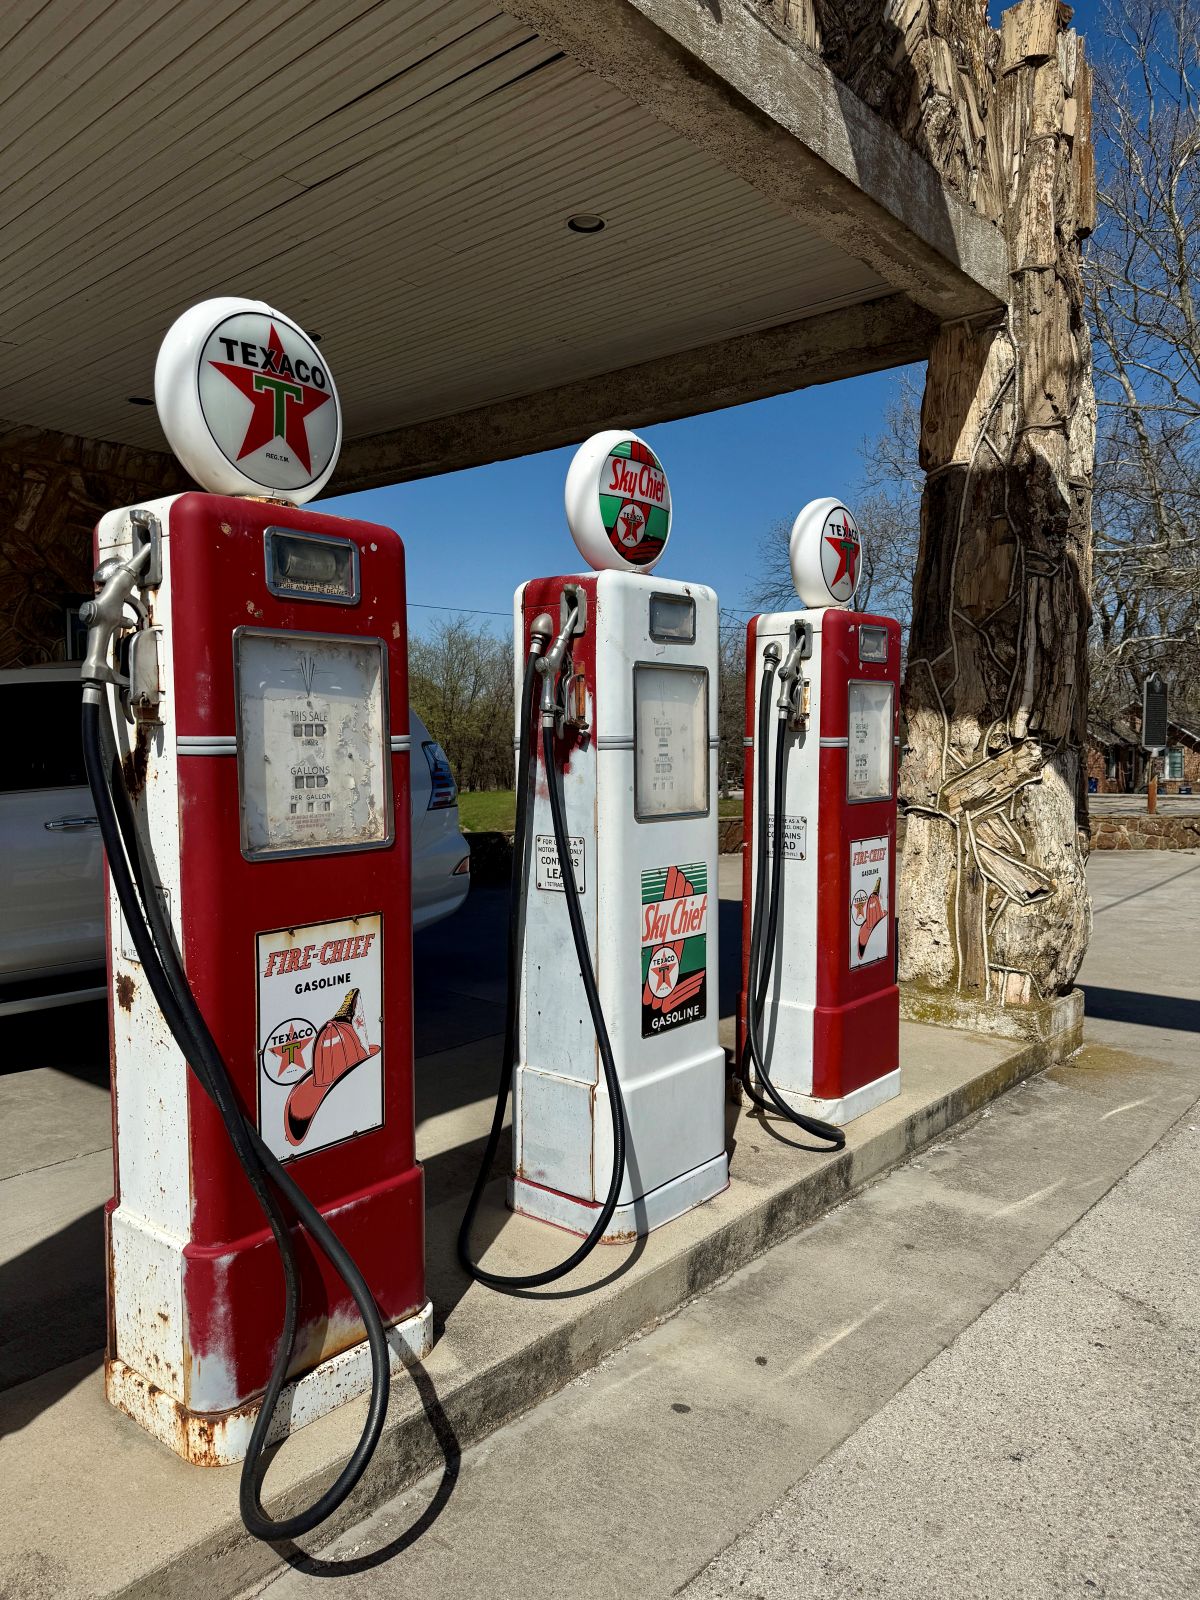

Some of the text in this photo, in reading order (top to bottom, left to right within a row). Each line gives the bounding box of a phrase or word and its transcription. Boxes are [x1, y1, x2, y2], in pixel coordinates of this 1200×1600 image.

[218, 336, 326, 389] TEXACO
[253, 372, 304, 440] T
[609, 458, 666, 503] Sky Chief
[623, 512, 643, 521] TEXACO
[829, 523, 859, 542] TEXACO
[840, 541, 855, 573] T
[290, 710, 328, 722] THIS SALE
[290, 765, 331, 775] GALLONS
[306, 793, 331, 801] GALLON
[641, 894, 708, 943] Sky Chief
[261, 933, 376, 978] FIRE-CHIEF
[653, 954, 675, 966] TEXACO
[294, 972, 352, 995] GASOLINE
[651, 1004, 700, 1030] GASOLINE
[271, 1027, 313, 1046] TEXACO
[281, 1040, 302, 1065] T
